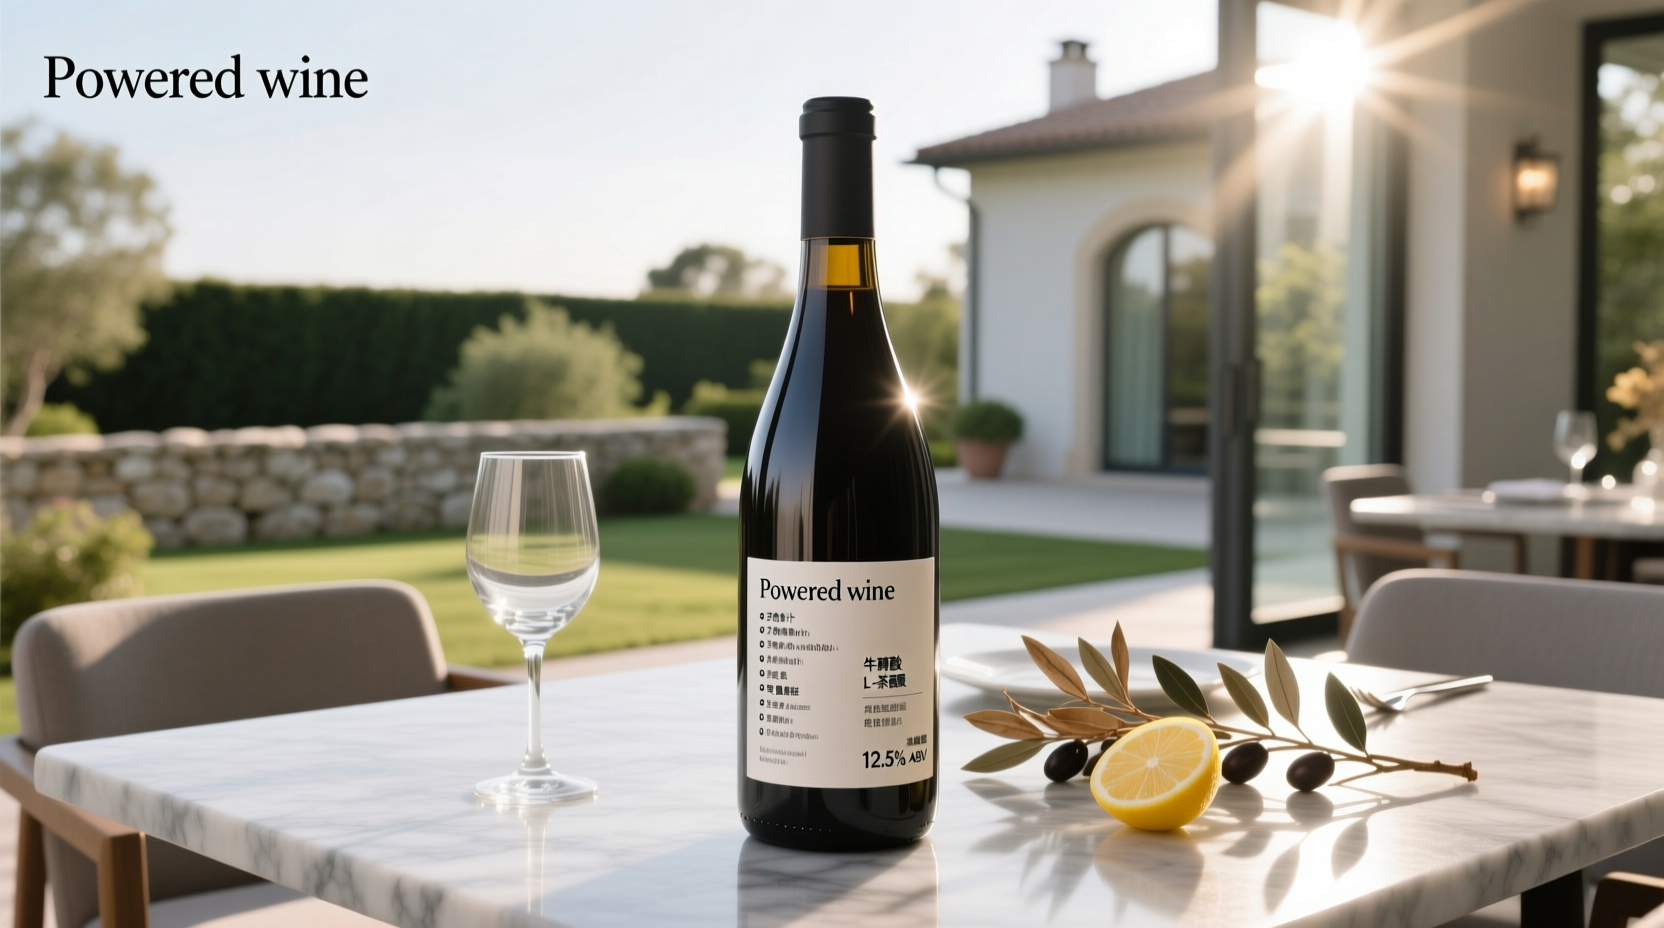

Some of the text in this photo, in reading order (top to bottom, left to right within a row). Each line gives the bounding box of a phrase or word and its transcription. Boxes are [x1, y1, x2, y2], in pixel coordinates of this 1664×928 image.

[760, 578, 895, 601] Powered wine
[862, 748, 928, 769] 12.5% ABV
